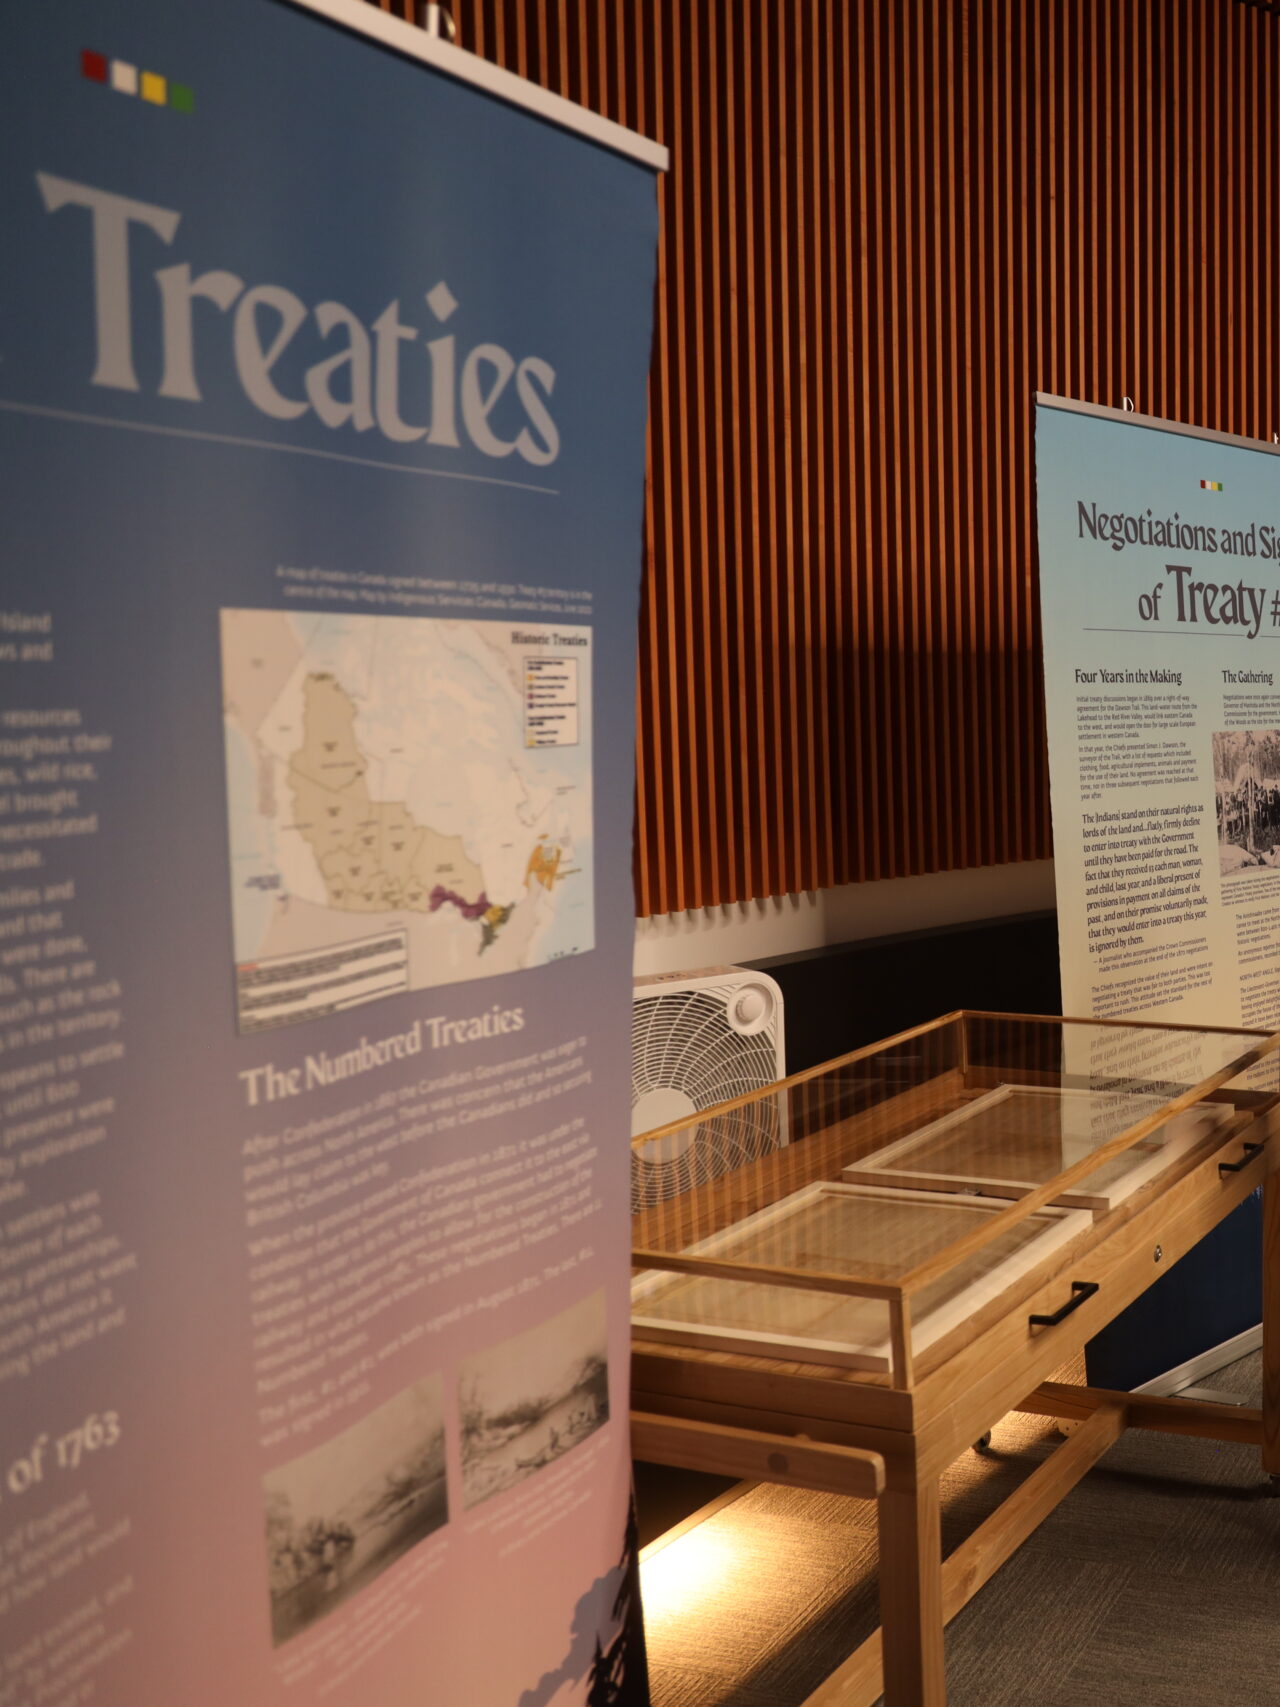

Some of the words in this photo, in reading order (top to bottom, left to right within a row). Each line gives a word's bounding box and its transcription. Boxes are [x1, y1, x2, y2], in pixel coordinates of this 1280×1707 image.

[36, 170, 560, 466] Treaties
[1077, 500, 1218, 553] Negotiations
[1221, 523, 1256, 557] and
[1138, 582, 1163, 622] of
[1165, 565, 1266, 640] Treaty
[511, 631, 549, 646] Historic
[552, 633, 588, 647] Treaties
[1075, 669, 1097, 683] Four
[1099, 669, 1124, 683] Years
[1126, 669, 1134, 683] in
[1135, 668, 1149, 683] the
[1150, 669, 1182, 686] Making
[1222, 670, 1236, 683] The
[1238, 670, 1273, 686] Gathering
[1082, 814, 1094, 824] The
[1121, 809, 1137, 820] stand
[1138, 810, 1146, 818] on
[1146, 808, 1159, 817] their
[1160, 805, 1180, 816] natural
[1181, 804, 1197, 815] rights
[1083, 828, 1099, 838] lords
[1100, 826, 1107, 837] of
[1108, 825, 1118, 836] the
[1118, 824, 1131, 834] land
[1164, 818, 1181, 829] firmly
[1182, 817, 1200, 827] decline
[1084, 845, 1090, 853] to
[1091, 843, 1107, 852] enter
[1108, 840, 1120, 850] into
[1121, 839, 1137, 849] treaty
[1138, 836, 1151, 846] with
[1152, 835, 1161, 844] the
[1162, 832, 1194, 843] Government
[1084, 856, 1099, 867] until
[1100, 855, 1113, 866] they
[1114, 853, 1127, 863] have
[1128, 852, 1141, 861] been
[1141, 849, 1154, 861] paid
[1154, 848, 1163, 858] for
[1164, 847, 1173, 857] the
[1174, 845, 1188, 855] road.
[1188, 844, 1198, 853] The
[1085, 871, 1097, 881] fact
[1097, 869, 1110, 880] that
[1111, 868, 1125, 878] they
[1125, 863, 1148, 876] received
[1154, 861, 1168, 871] each
[1168, 861, 1181, 869] man,
[1182, 858, 1203, 867] woman,
[1086, 885, 1098, 896] and
[1099, 882, 1116, 894] child,
[1116, 882, 1126, 891] last
[1127, 881, 1140, 892] year,
[1141, 877, 1152, 887] and
[1157, 873, 1174, 885] liberal
[1174, 872, 1194, 884] present
[1195, 869, 1200, 879] of
[1087, 898, 1118, 912] provisions
[1119, 896, 1125, 905] in
[1126, 893, 1150, 906] payment
[1151, 892, 1158, 900] on
[1159, 888, 1167, 898] all
[1167, 887, 1184, 897] claims
[1185, 884, 1191, 894] of
[1192, 883, 1200, 893] the
[1088, 915, 1104, 927] past,
[1104, 910, 1116, 922] and
[1116, 911, 1124, 920] on
[1125, 907, 1140, 918] their
[1140, 904, 1162, 917] promise
[1163, 898, 1192, 911] voluntarily
[1088, 928, 1101, 939] that
[1102, 926, 1115, 937] they
[1117, 921, 1135, 933] would
[1136, 921, 1150, 930] enter
[1150, 918, 1162, 927] into
[1167, 915, 1182, 924] treaty
[1184, 911, 1194, 921] this
[1089, 944, 1095, 953] is
[1094, 938, 1119, 954] ignored
[1120, 938, 1127, 949] by
[1128, 936, 1144, 946] them.
[238, 1062, 300, 1106] The
[304, 1020, 421, 1090] Numbered
[425, 1004, 525, 1050] Treaties
[7, 1432, 48, 1493] of
[56, 1410, 121, 1468] 1763
